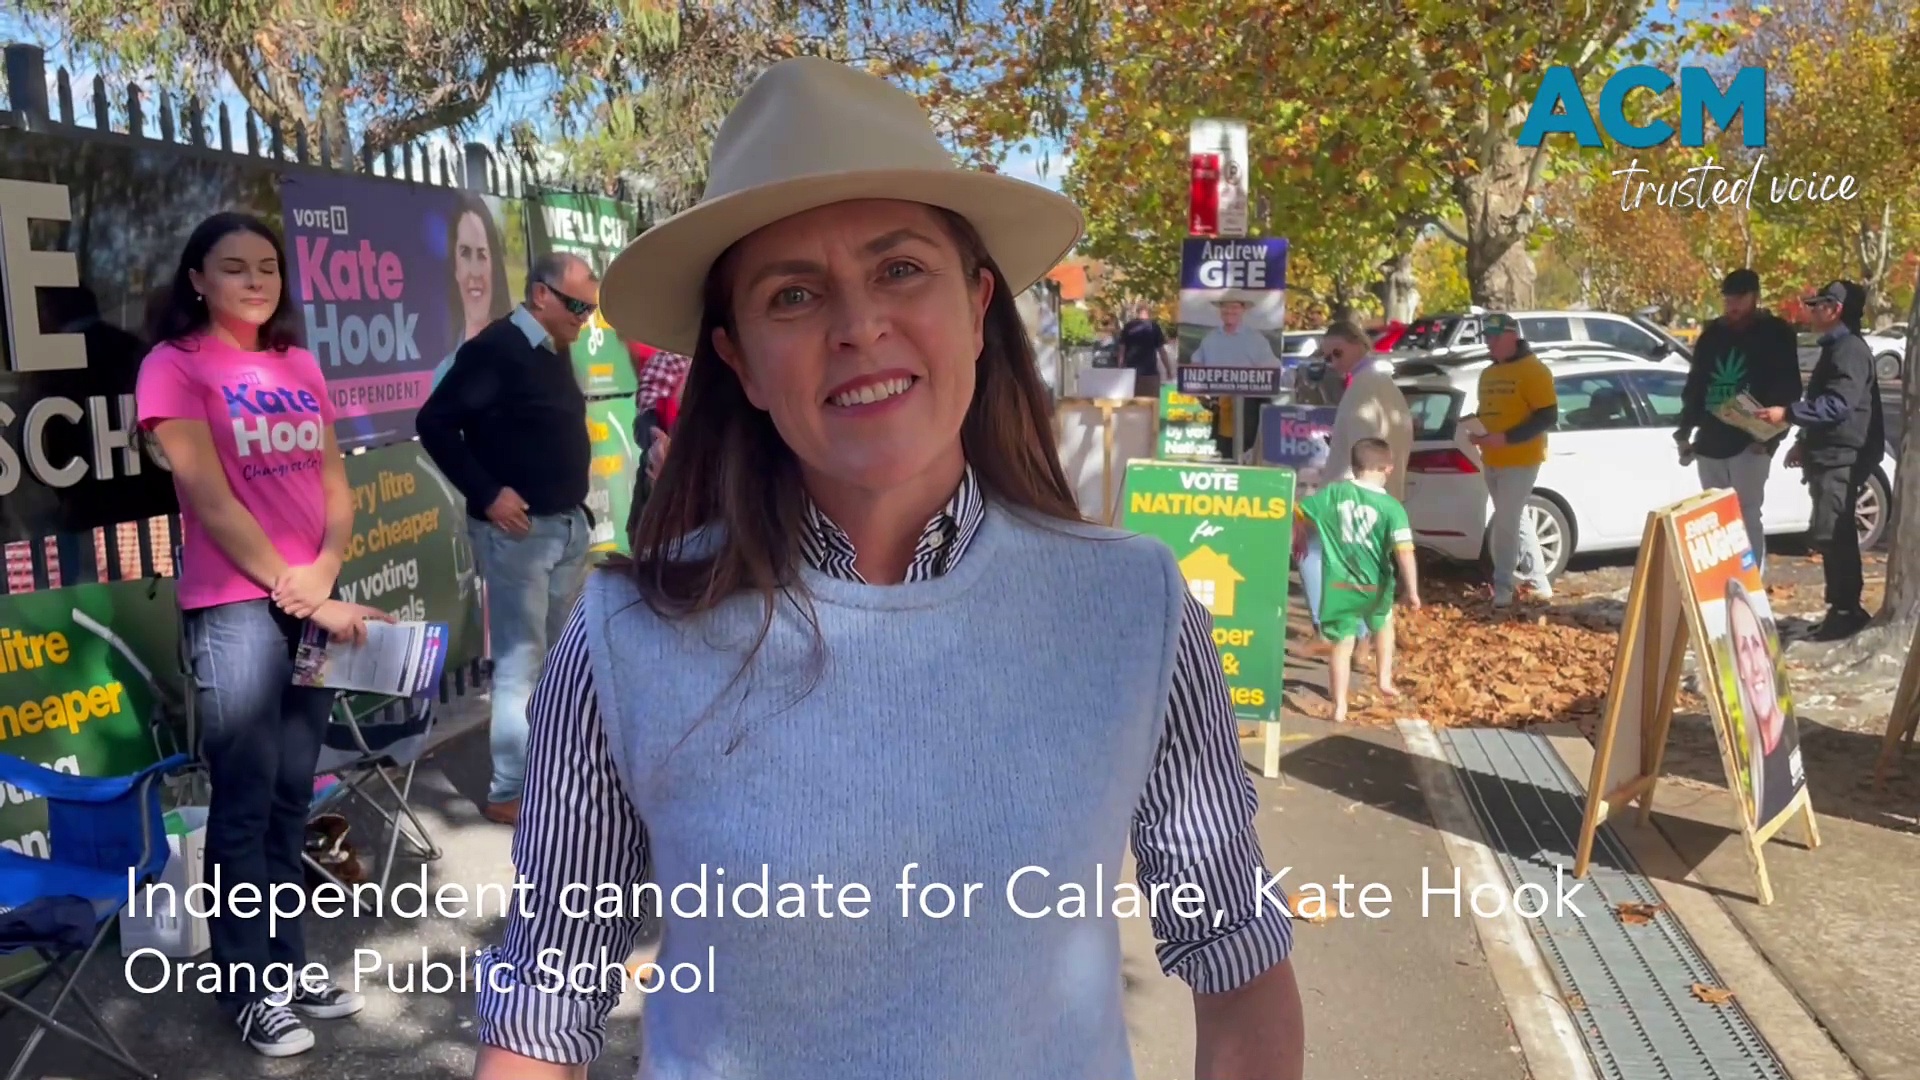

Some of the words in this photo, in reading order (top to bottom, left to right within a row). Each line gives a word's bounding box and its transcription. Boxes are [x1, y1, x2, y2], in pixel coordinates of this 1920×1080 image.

[293, 208, 330, 229] VOTE
[541, 205, 599, 244] WE'LL
[1202, 240, 1268, 260] Andrew
[295, 236, 405, 301] Kate
[1199, 260, 1266, 288] GEE
[303, 302, 422, 367] Hook
[1183, 369, 1274, 383] INDEPENDENT
[222, 383, 320, 418] Kate
[332, 380, 421, 408] NDEPENDENT
[0, 394, 172, 497] CH
[379, 470, 416, 503] litre
[1180, 471, 1239, 491] VOTE
[1131, 492, 1287, 519] NATIONALS
[368, 507, 440, 553] cheaper
[1190, 520, 1224, 543] for
[1337, 499, 1379, 547] 12
[360, 558, 419, 601] voting
[1222, 652, 1240, 675] &
[0, 681, 123, 740] eaper
